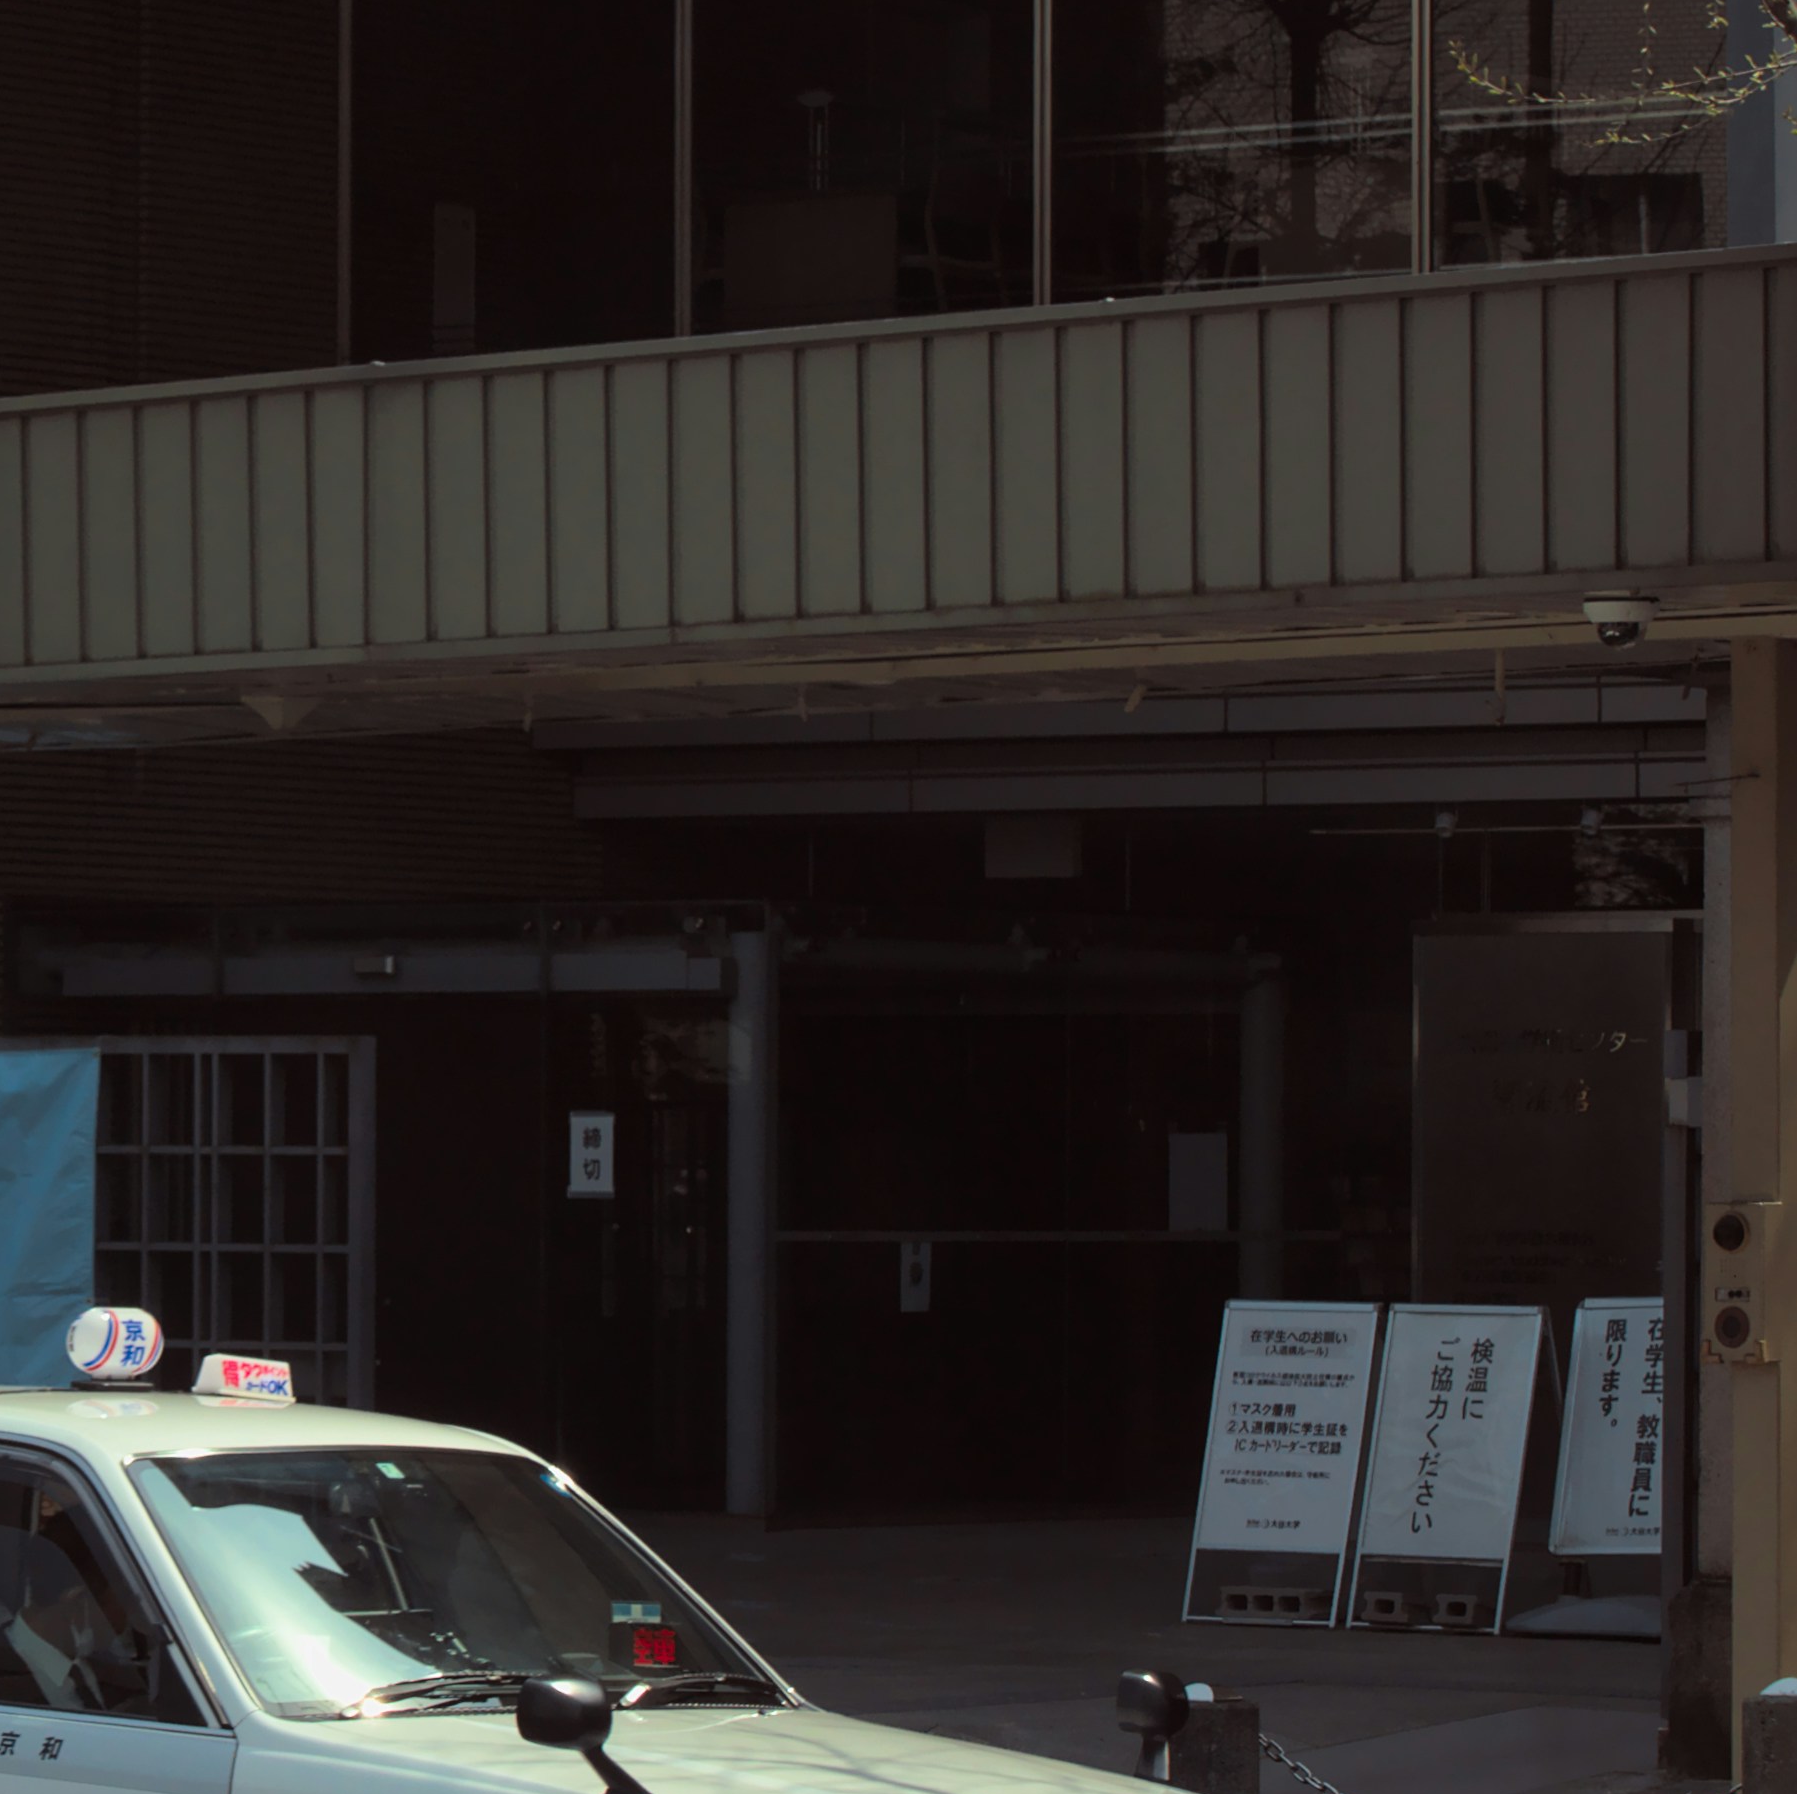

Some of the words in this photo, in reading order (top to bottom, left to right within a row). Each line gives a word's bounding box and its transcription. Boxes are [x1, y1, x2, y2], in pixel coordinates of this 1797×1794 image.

[120, 1319, 146, 1367] 京和
[1250, 1329, 1348, 1345] 在学生へのお願い
[1461, 1337, 1496, 1421] 検温に
[1598, 1318, 1628, 1429] 限ります。
[1410, 1337, 1463, 1535] ご協力ください
